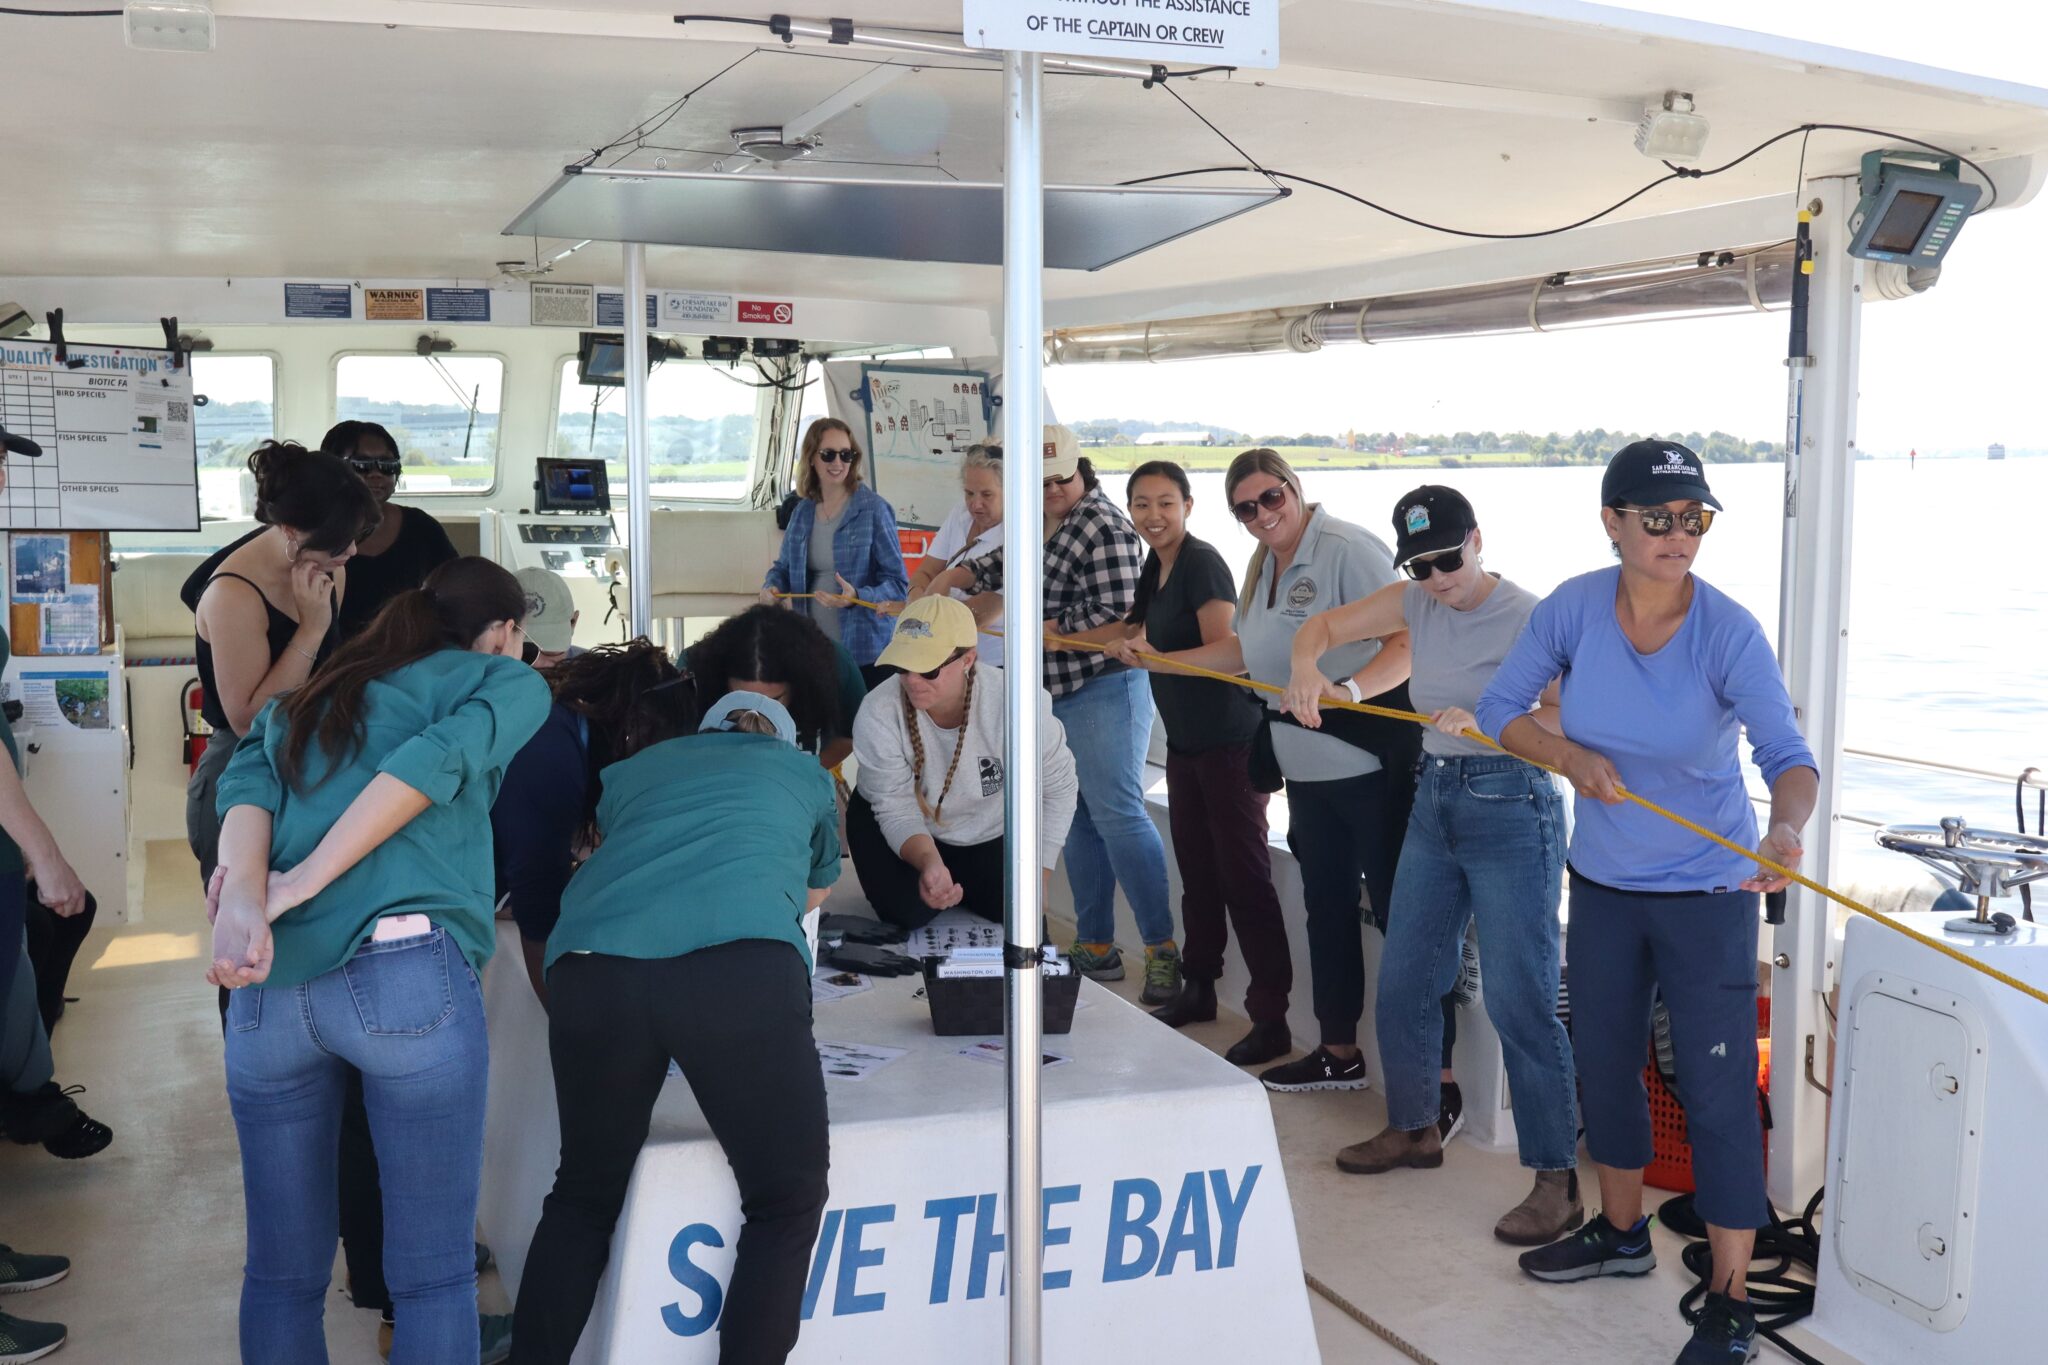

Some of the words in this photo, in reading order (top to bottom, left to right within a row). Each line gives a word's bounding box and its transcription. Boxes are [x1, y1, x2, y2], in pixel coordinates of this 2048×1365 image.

[1166, 0, 1250, 16] ASSISTANCE
[1026, 15, 1048, 31] OF
[1053, 17, 1082, 33] THE
[1087, 19, 1151, 38] CAPTAIN
[1156, 24, 1178, 40] OR
[1182, 27, 1224, 44] CREW
[369, 291, 419, 299] WARNING
[682, 305, 720, 313] FOUNDATION
[742, 311, 770, 321] Smoking
[88, 377, 116, 387] BIOTIC
[56, 389, 75, 397] BIRD
[76, 390, 107, 399] SPECIES
[58, 433, 76, 441] FISH
[77, 434, 107, 442] SPECIES
[89, 485, 119, 493] SPECIES
[660, 1203, 896, 1338] SVE
[1102, 1165, 1262, 1283] BAY
